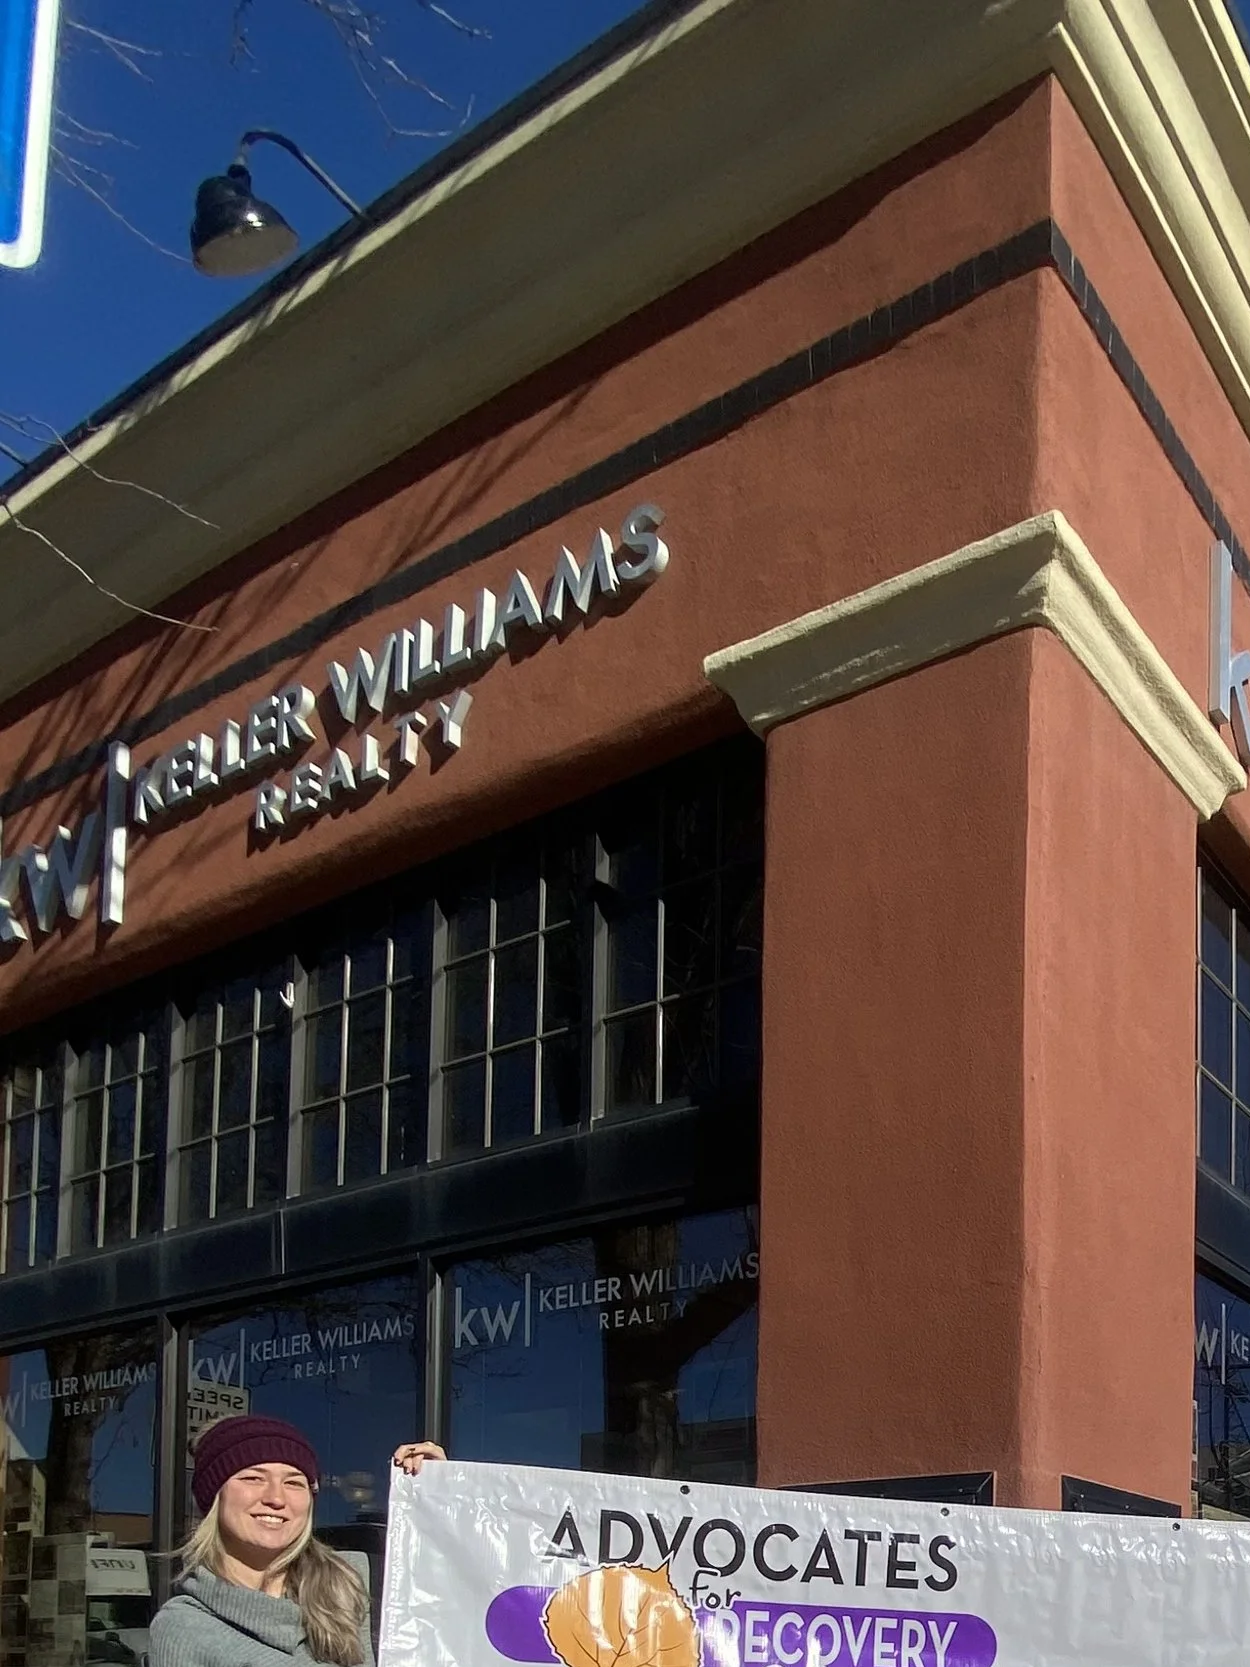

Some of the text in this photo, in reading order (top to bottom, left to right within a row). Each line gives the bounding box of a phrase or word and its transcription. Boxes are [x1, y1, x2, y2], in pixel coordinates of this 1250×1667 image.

[134, 684, 315, 825] KELLER
[328, 504, 670, 725] WILLIAMS
[255, 690, 473, 831] REALTY
[539, 1277, 622, 1312] KELLER
[629, 1252, 759, 1297] WILLIAMS
[600, 1300, 688, 1329] REALTY
[251, 1333, 312, 1362] KELLER
[318, 1314, 415, 1349] WILLIAMS
[30, 1376, 79, 1401] KELLER
[83, 1361, 157, 1392] WILLIAMS
[295, 1353, 361, 1379] REALTY
[64, 1395, 117, 1417] REALTY
[544, 1506, 958, 1592] ADVOCATES
[689, 1569, 741, 1609] for
